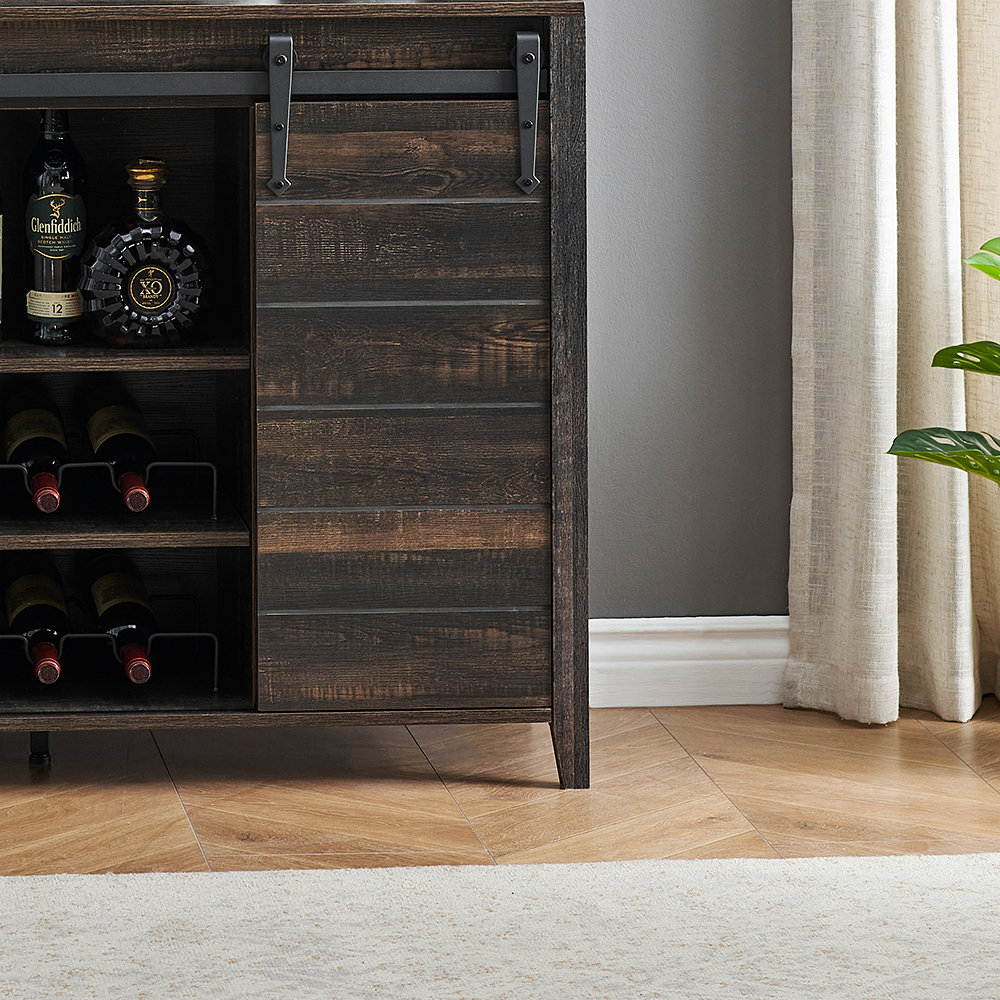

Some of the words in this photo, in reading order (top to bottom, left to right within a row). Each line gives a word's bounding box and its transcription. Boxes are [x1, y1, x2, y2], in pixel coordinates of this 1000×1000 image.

[31, 216, 81, 234] Glenfiddich
[140, 280, 163, 295] XO
[51, 304, 63, 314] 12
